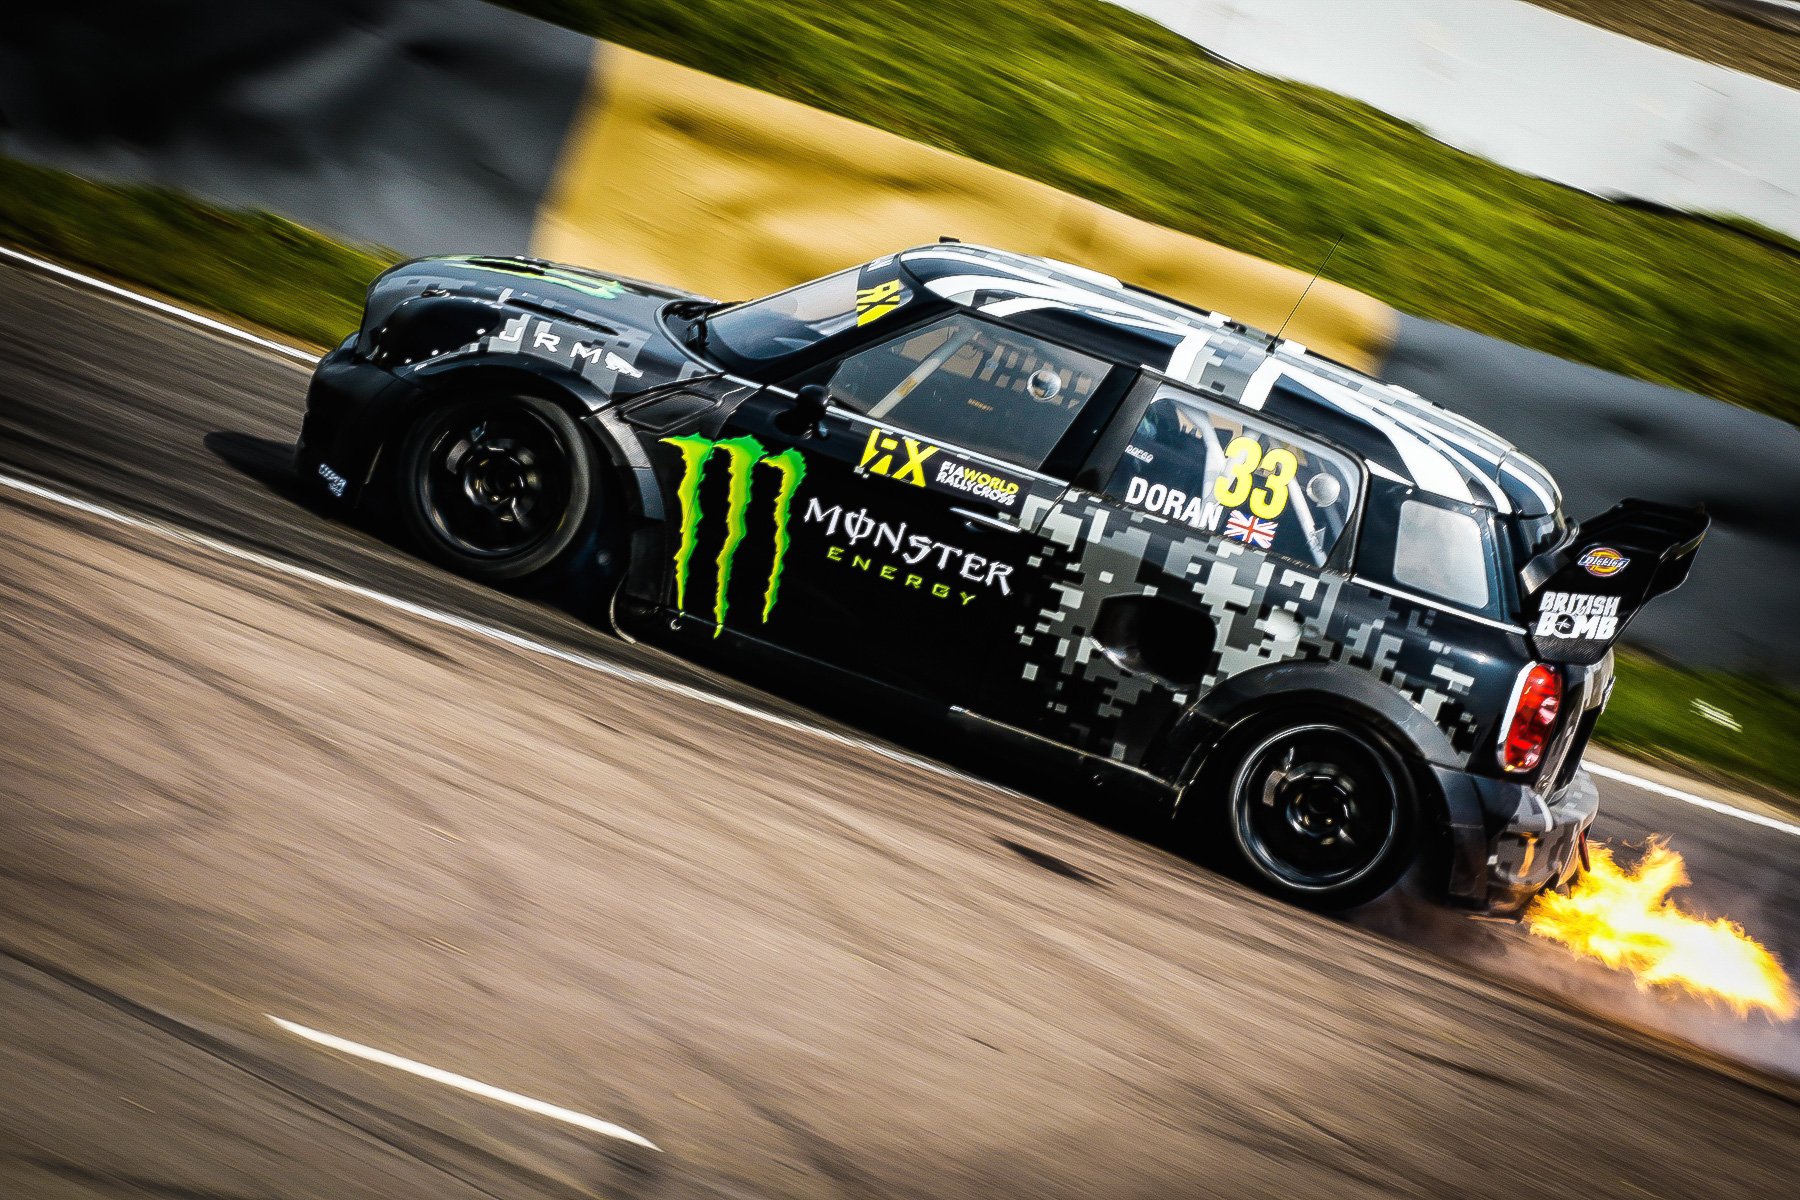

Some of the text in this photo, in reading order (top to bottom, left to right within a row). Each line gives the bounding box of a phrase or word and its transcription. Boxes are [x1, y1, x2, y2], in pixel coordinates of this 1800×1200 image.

[499, 325, 603, 364] JRM
[935, 471, 1017, 505] RALLYCROSS
[1214, 436, 1298, 520] 33
[1125, 476, 1224, 532] DORAN
[803, 497, 1014, 595] MONSTER
[826, 546, 976, 605] ENERGY
[1534, 611, 1619, 640] BOMB
[1539, 591, 1621, 617] BRITISH
